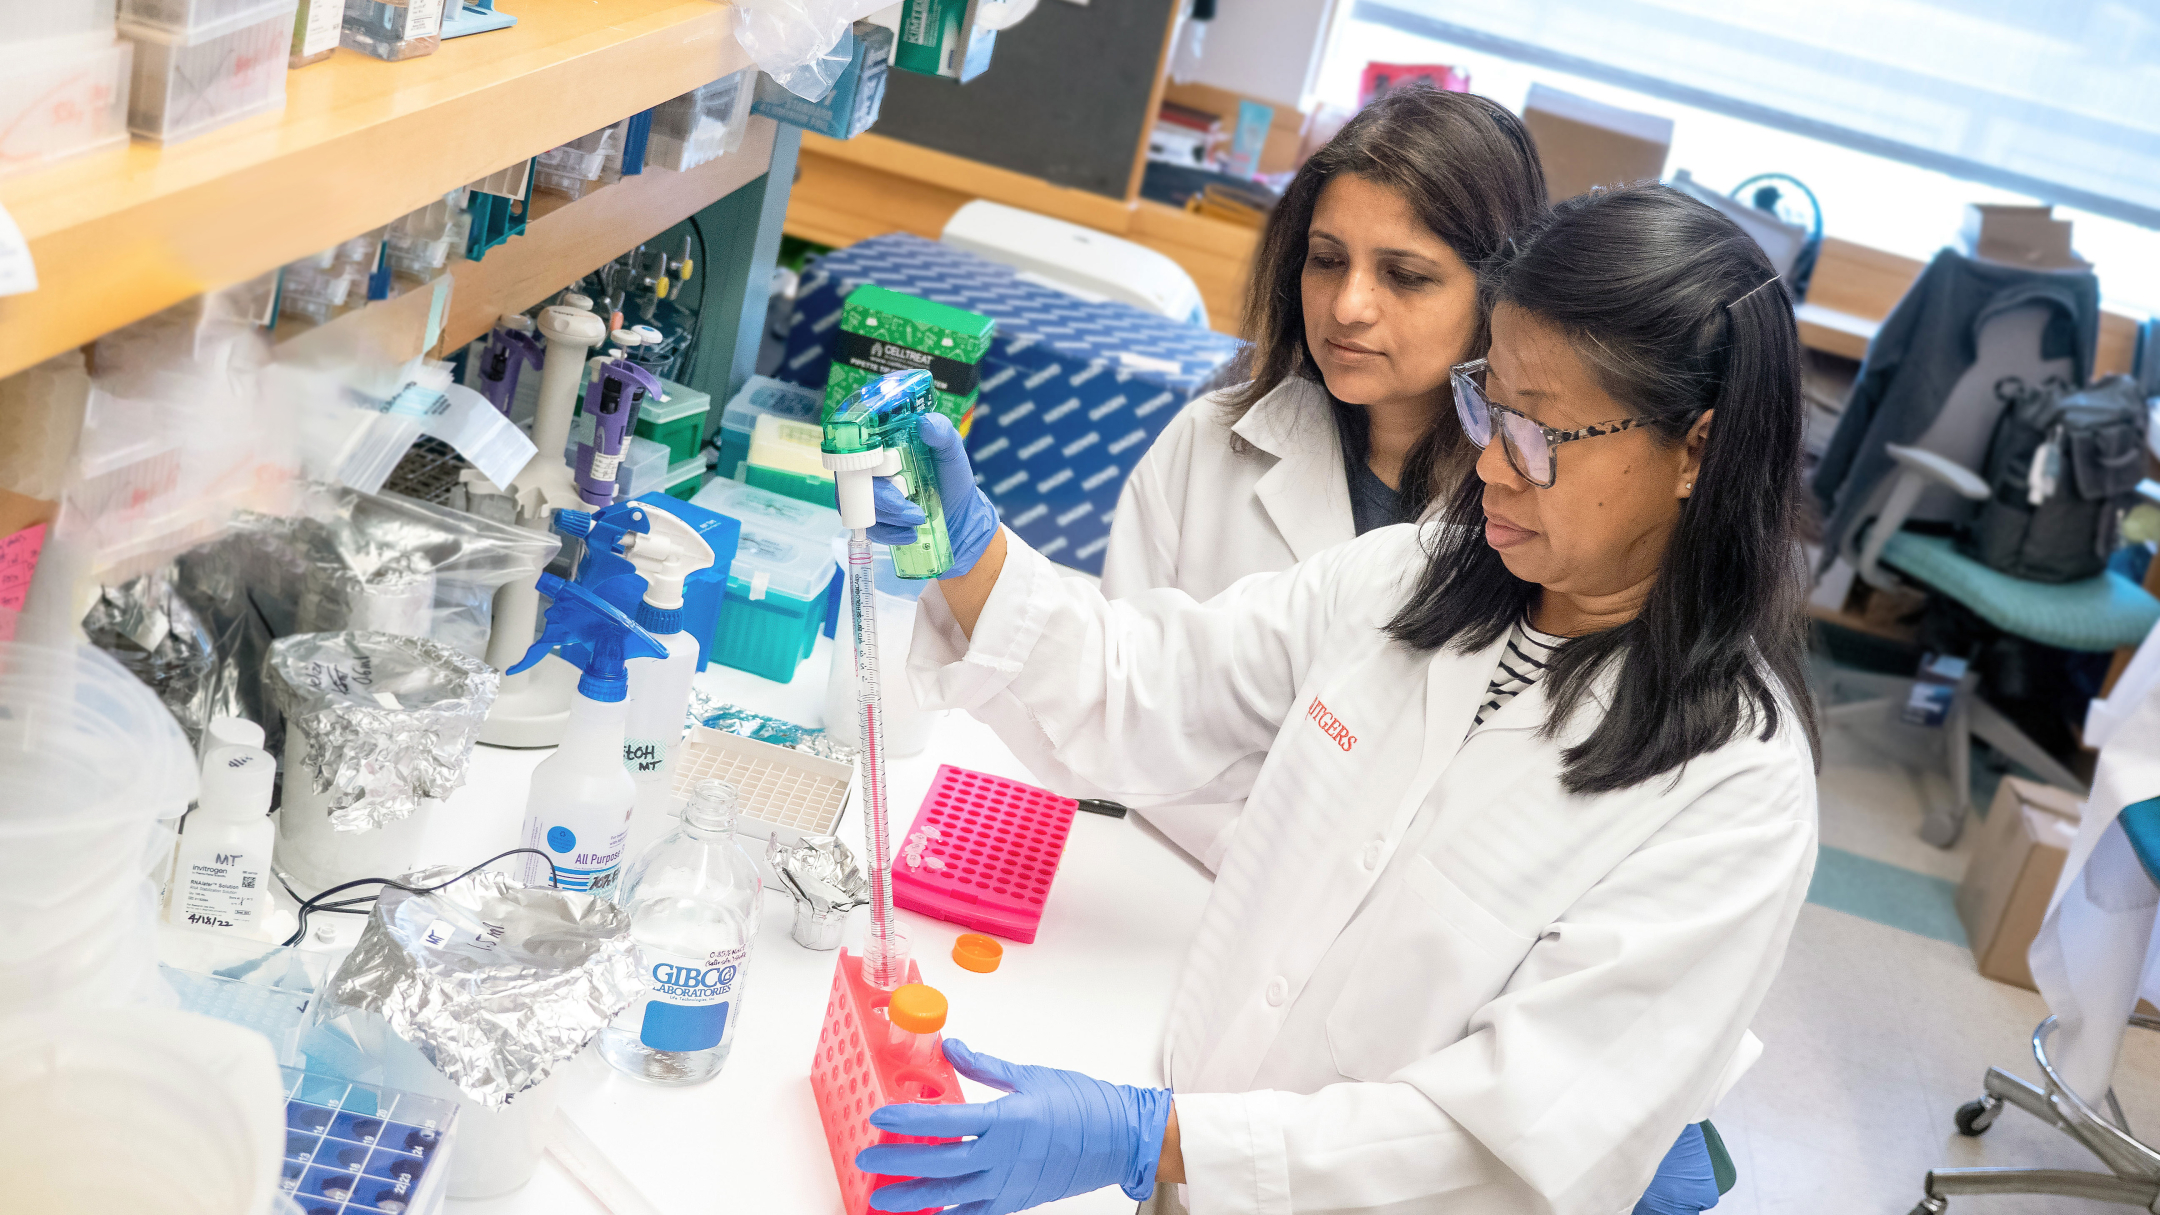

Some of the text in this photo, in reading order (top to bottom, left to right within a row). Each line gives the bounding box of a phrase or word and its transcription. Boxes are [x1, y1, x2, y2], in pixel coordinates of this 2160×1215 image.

[884, 344, 933, 365] CELLTREAT
[1304, 692, 1358, 752] UTGERS
[638, 760, 663, 771] MT
[215, 853, 243, 867] MT
[575, 853, 588, 865] All
[192, 864, 228, 875] invitrogen
[188, 914, 233, 927] 4/18/22
[652, 963, 737, 989] GIBCO
[652, 983, 732, 998] LABORATORIES
[376, 1109, 388, 1119] 20
[313, 1125, 325, 1135] 14
[363, 1135, 375, 1145] 19
[298, 1152, 311, 1162] 13
[412, 1145, 425, 1157] 24
[349, 1162, 361, 1173] 18
[400, 1172, 412, 1185] 23
[394, 1182, 407, 1195] 22
[334, 1190, 347, 1201] 17
